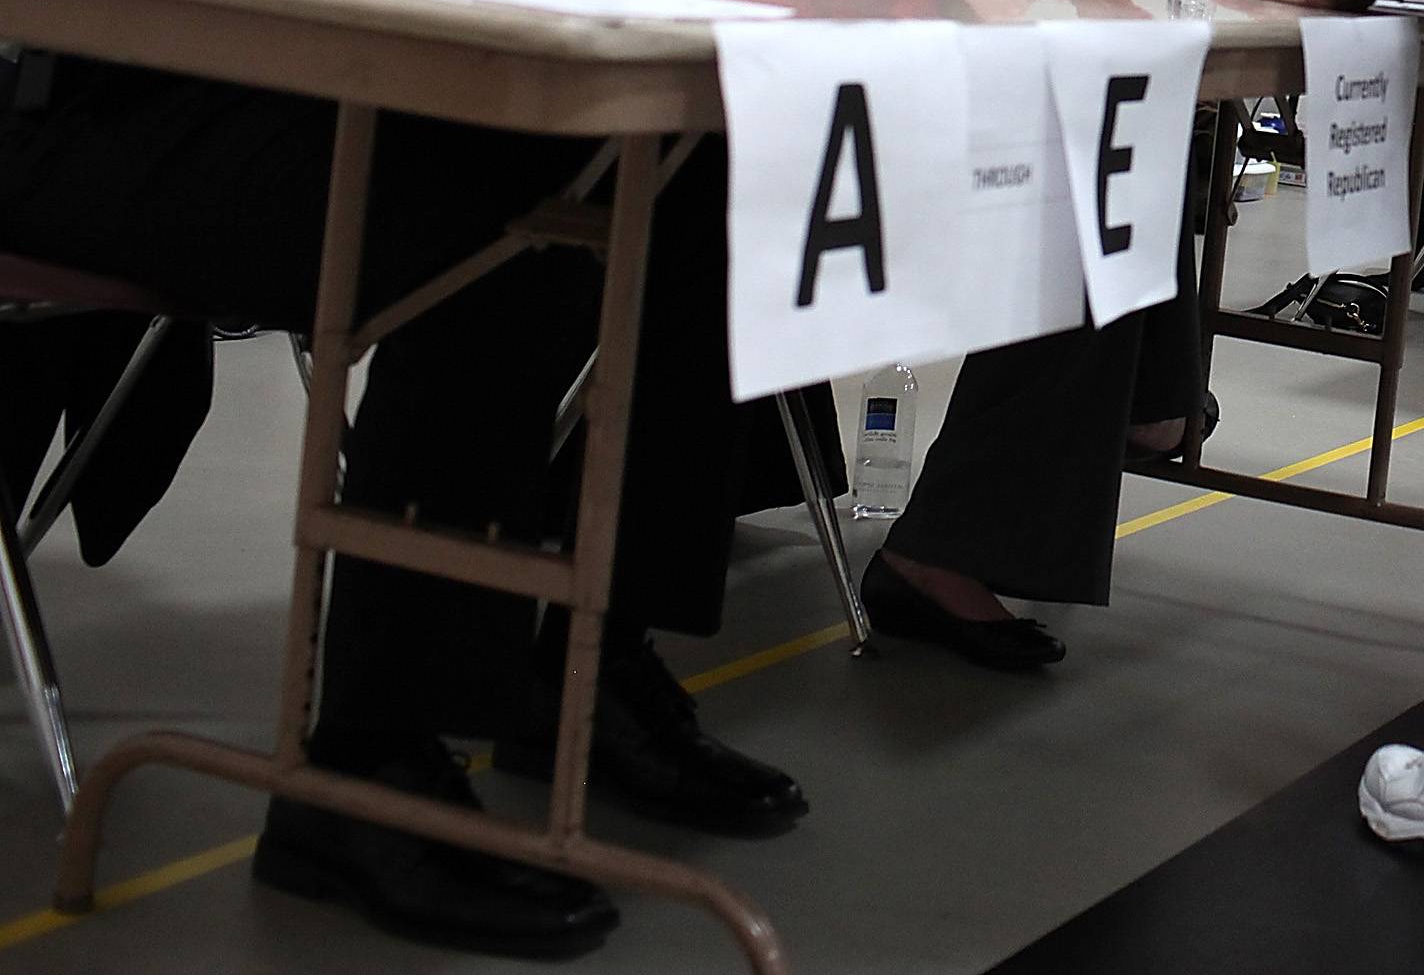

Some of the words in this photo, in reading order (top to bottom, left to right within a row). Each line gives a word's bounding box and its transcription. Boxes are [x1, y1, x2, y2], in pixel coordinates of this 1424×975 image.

[1335, 72, 1390, 104] Currently
[1328, 117, 1388, 155] Registered
[793, 82, 886, 308] A
[972, 163, 1033, 191] THROUGH
[1095, 75, 1150, 257] E
[1326, 163, 1385, 200] Republican
